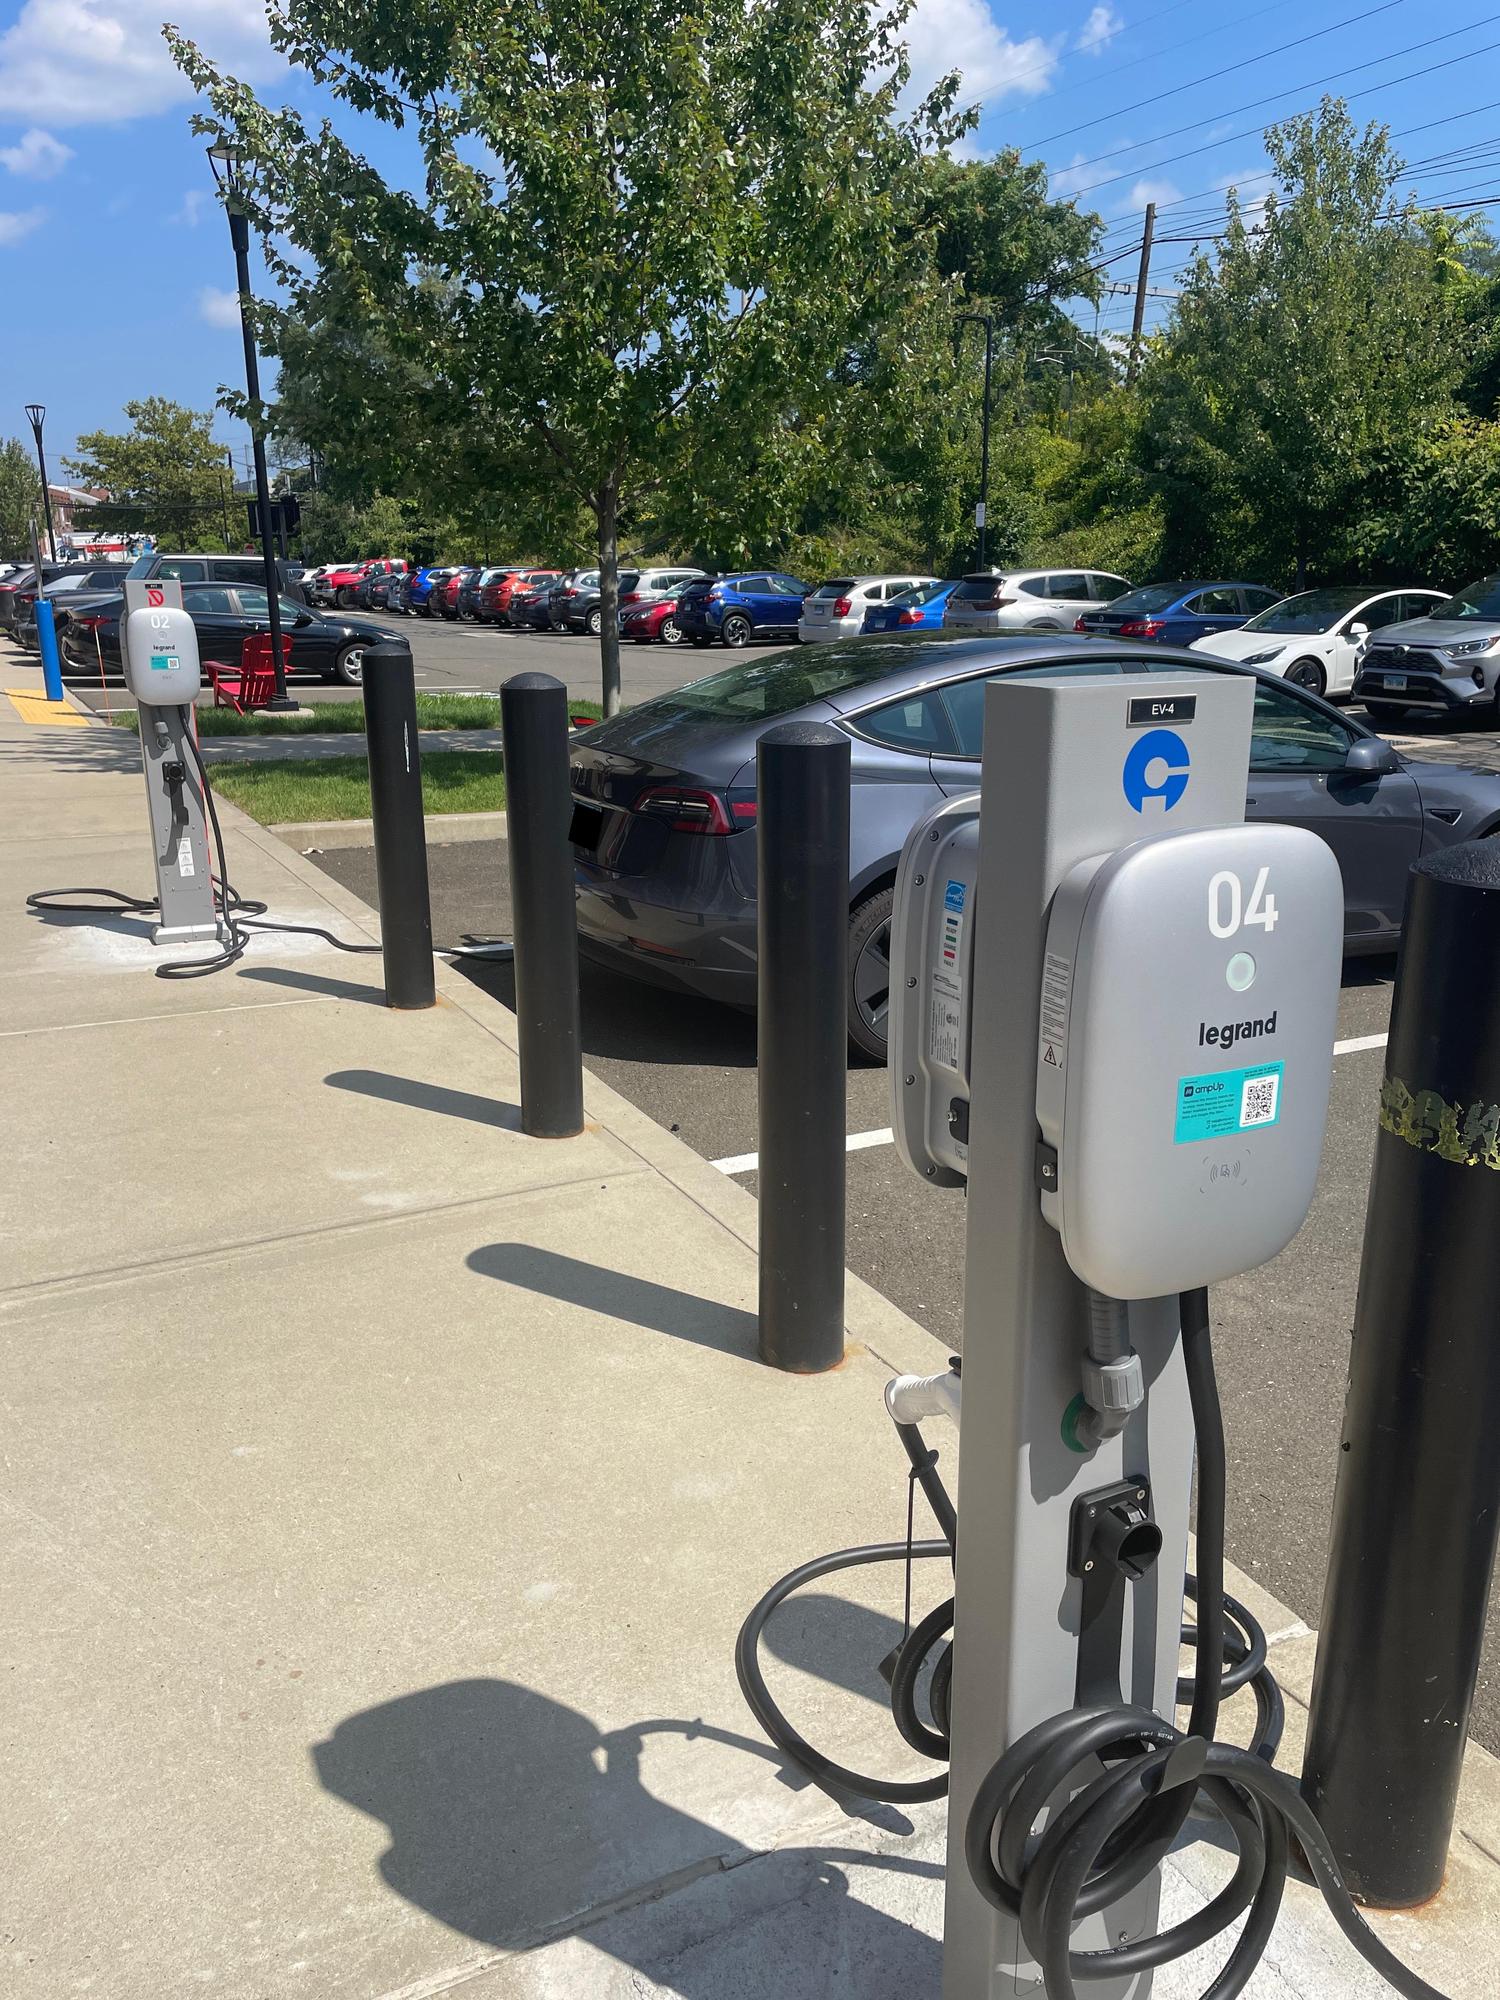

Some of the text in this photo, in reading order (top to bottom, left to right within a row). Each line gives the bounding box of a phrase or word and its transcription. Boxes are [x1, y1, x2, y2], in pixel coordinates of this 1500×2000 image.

[151, 614, 171, 629] 02
[1151, 703, 1175, 716] EV-4
[1208, 866, 1279, 939] 04
[1199, 1010, 1277, 1050] legrand
[1195, 1082, 1225, 1095] ampUp
